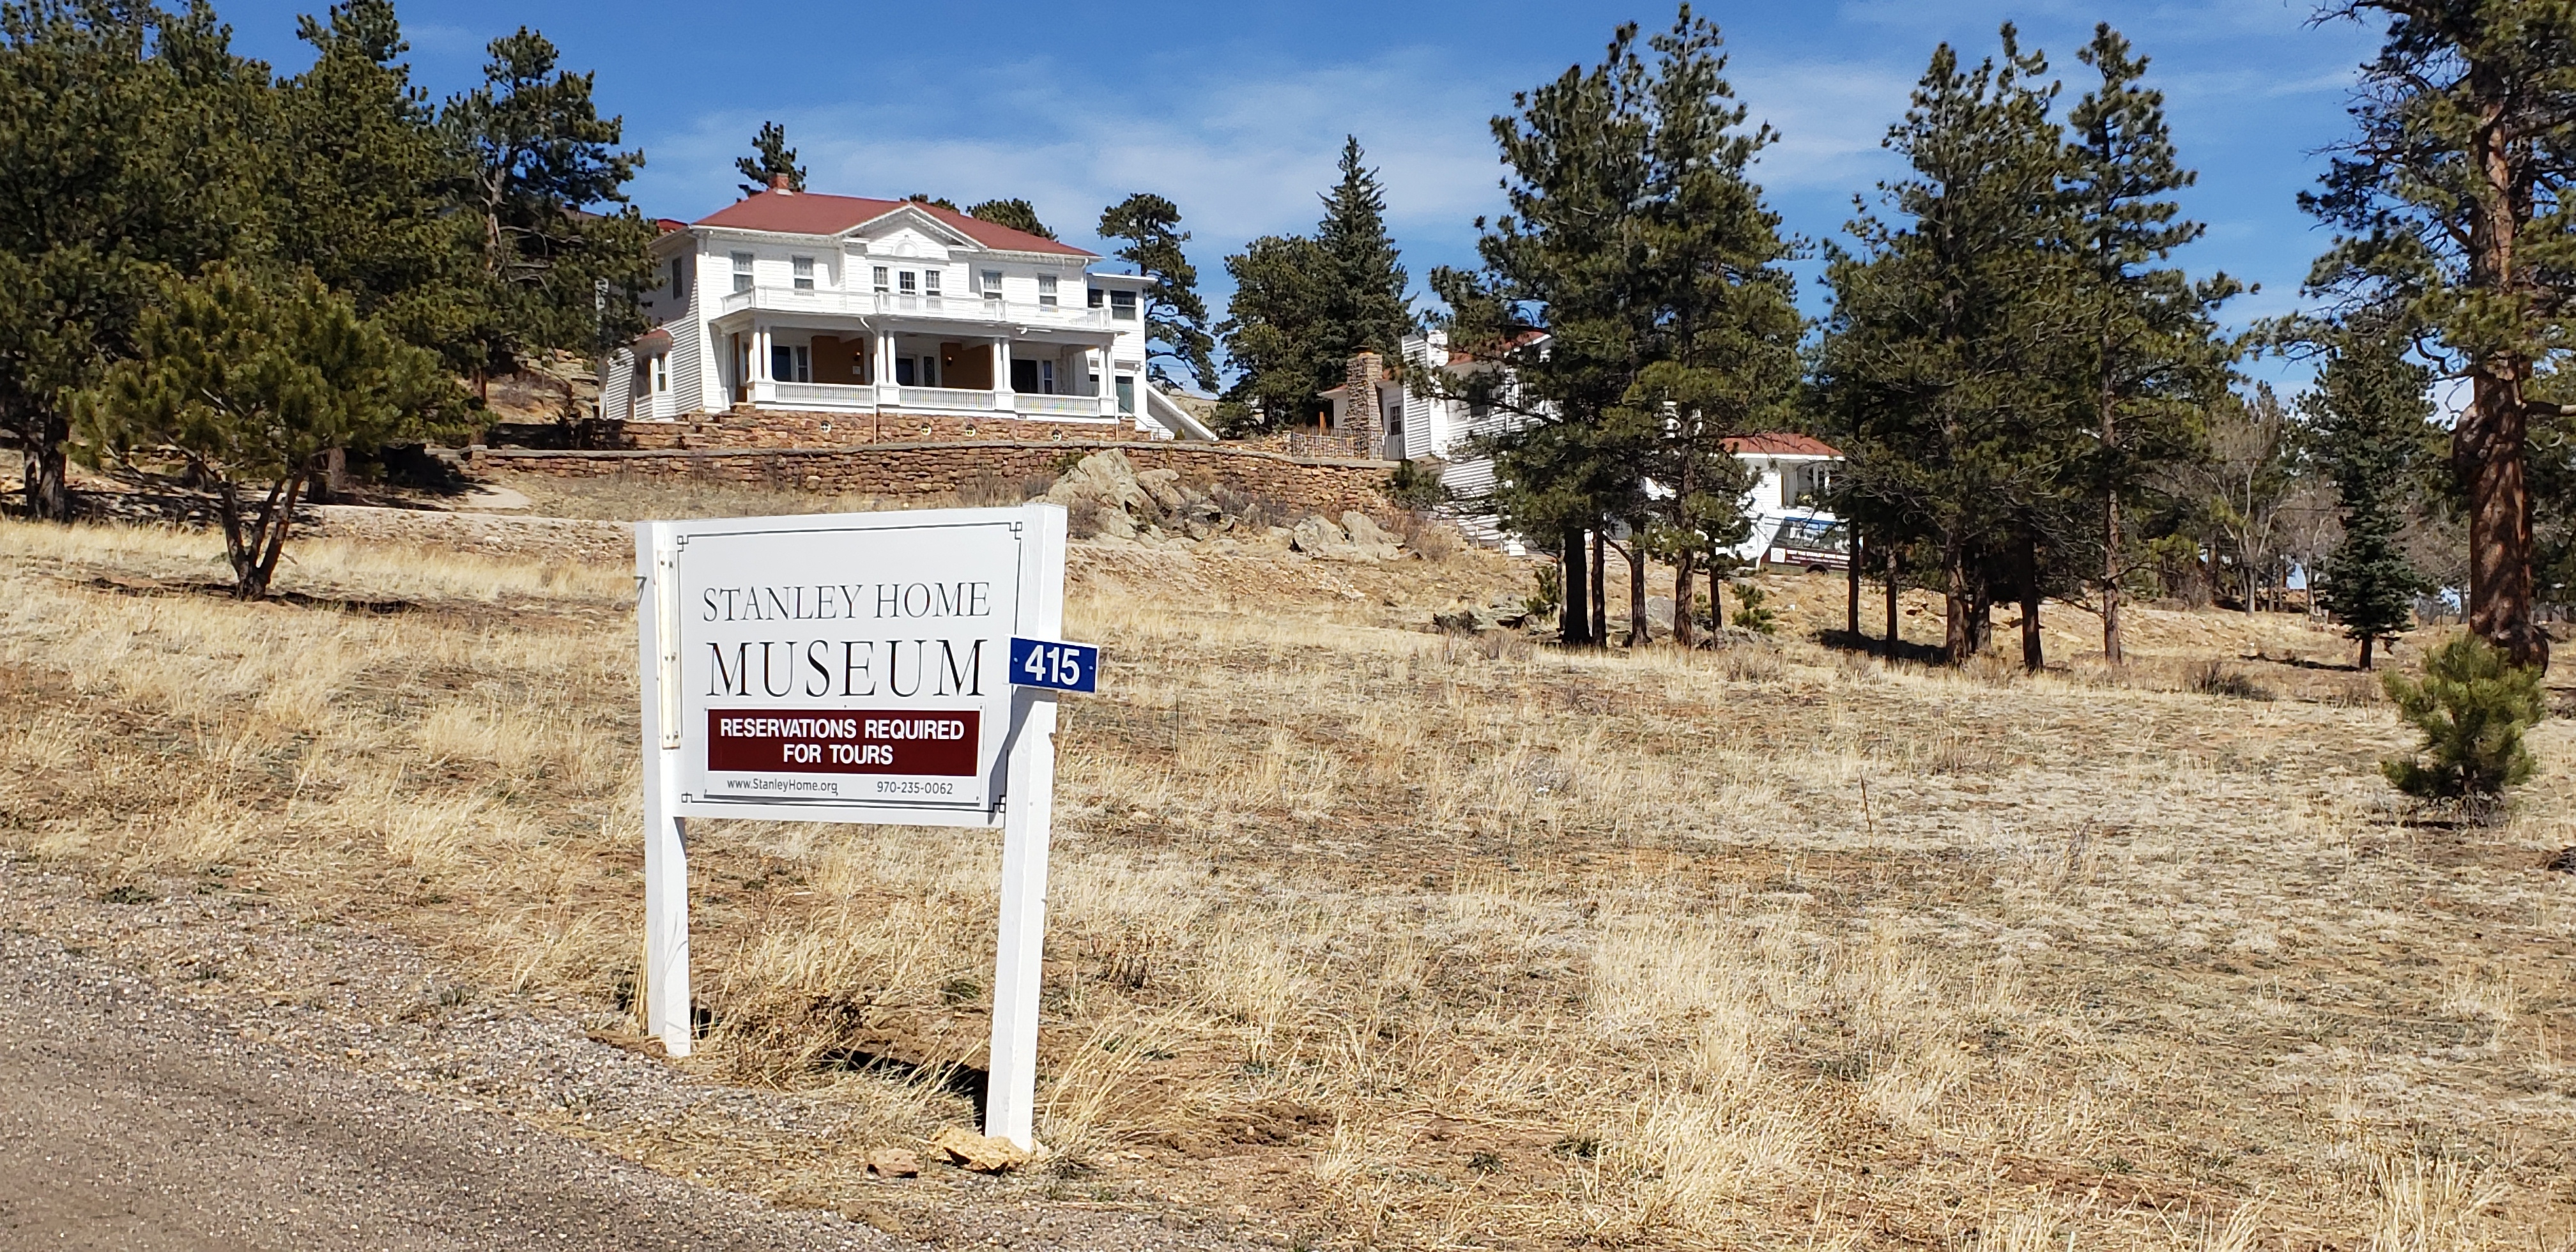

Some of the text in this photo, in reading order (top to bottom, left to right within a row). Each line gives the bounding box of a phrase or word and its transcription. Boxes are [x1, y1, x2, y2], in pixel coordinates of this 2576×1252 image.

[703, 581, 991, 622] STANLEY HOME
[705, 639, 988, 698] MUSEUM
[1024, 645, 1080, 685] 415
[720, 718, 965, 740] RESERVATIONS REQUIRED
[783, 744, 894, 765] FOR TOURS
[726, 778, 954, 795] www.StanleyHome.org 970-235-0062
